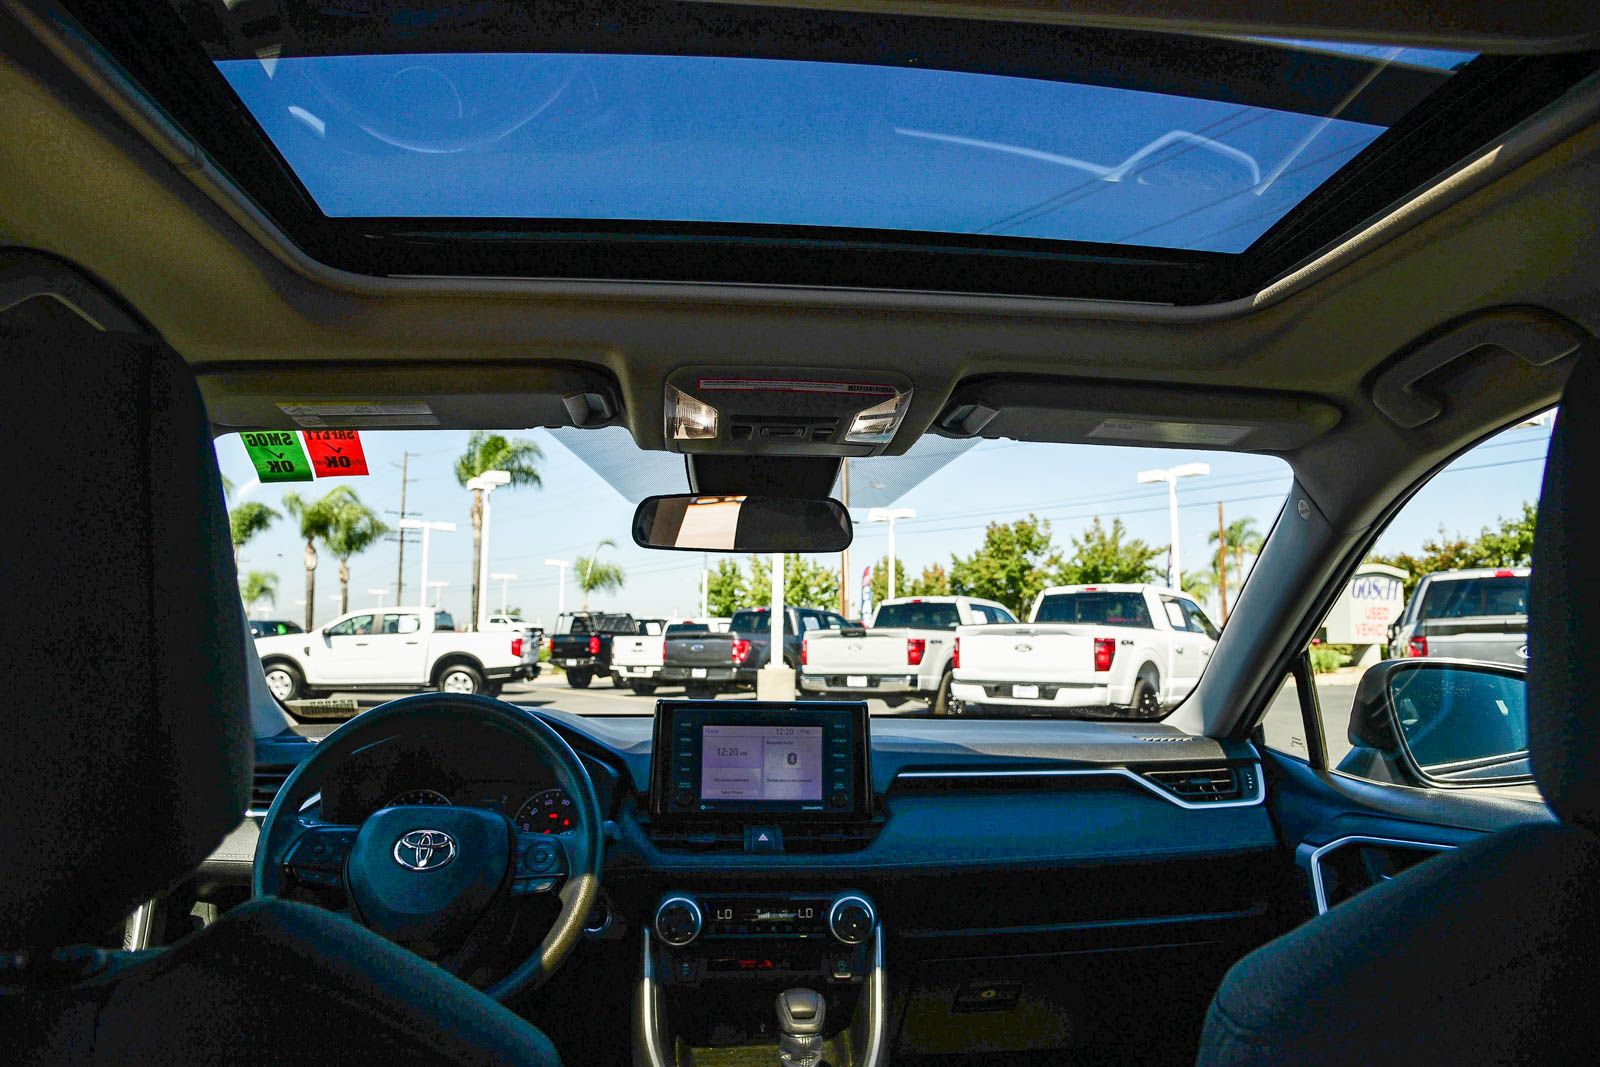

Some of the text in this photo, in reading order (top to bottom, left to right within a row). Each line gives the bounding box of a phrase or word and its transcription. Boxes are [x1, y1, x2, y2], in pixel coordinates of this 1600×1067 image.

[1352, 577, 1399, 601] GOSCH
[776, 728, 794, 736] 12:20
[717, 747, 739, 757] 12:20
[717, 909, 732, 920] LO
[798, 908, 814, 919] LO
